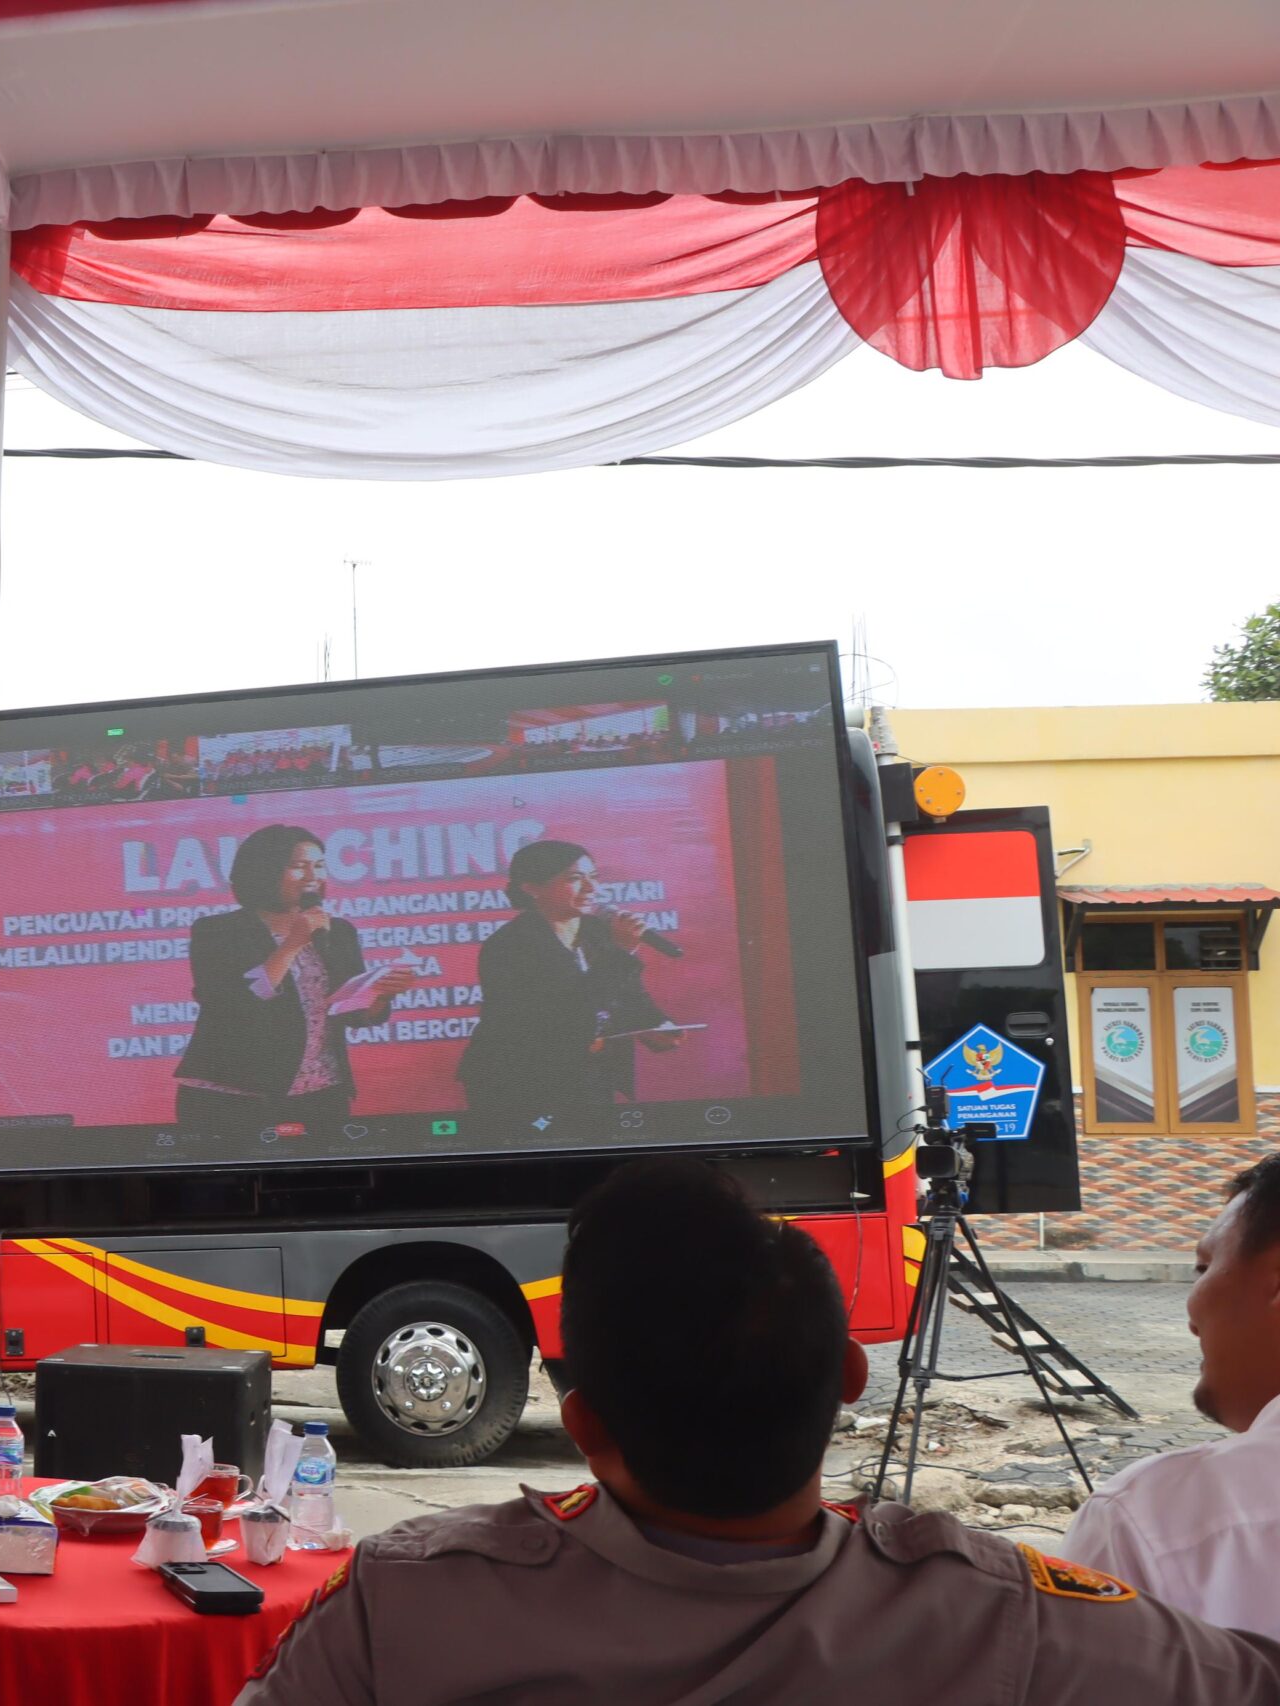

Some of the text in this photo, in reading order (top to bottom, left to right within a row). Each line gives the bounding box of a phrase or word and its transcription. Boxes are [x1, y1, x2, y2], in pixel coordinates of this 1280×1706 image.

[4, 908, 153, 936] PENGUATAN
[455, 922, 473, 943] &
[108, 1036, 162, 1058] DAN
[957, 1111, 1017, 1119] PENANGANAN
[990, 1103, 1016, 1111] TUGAS
